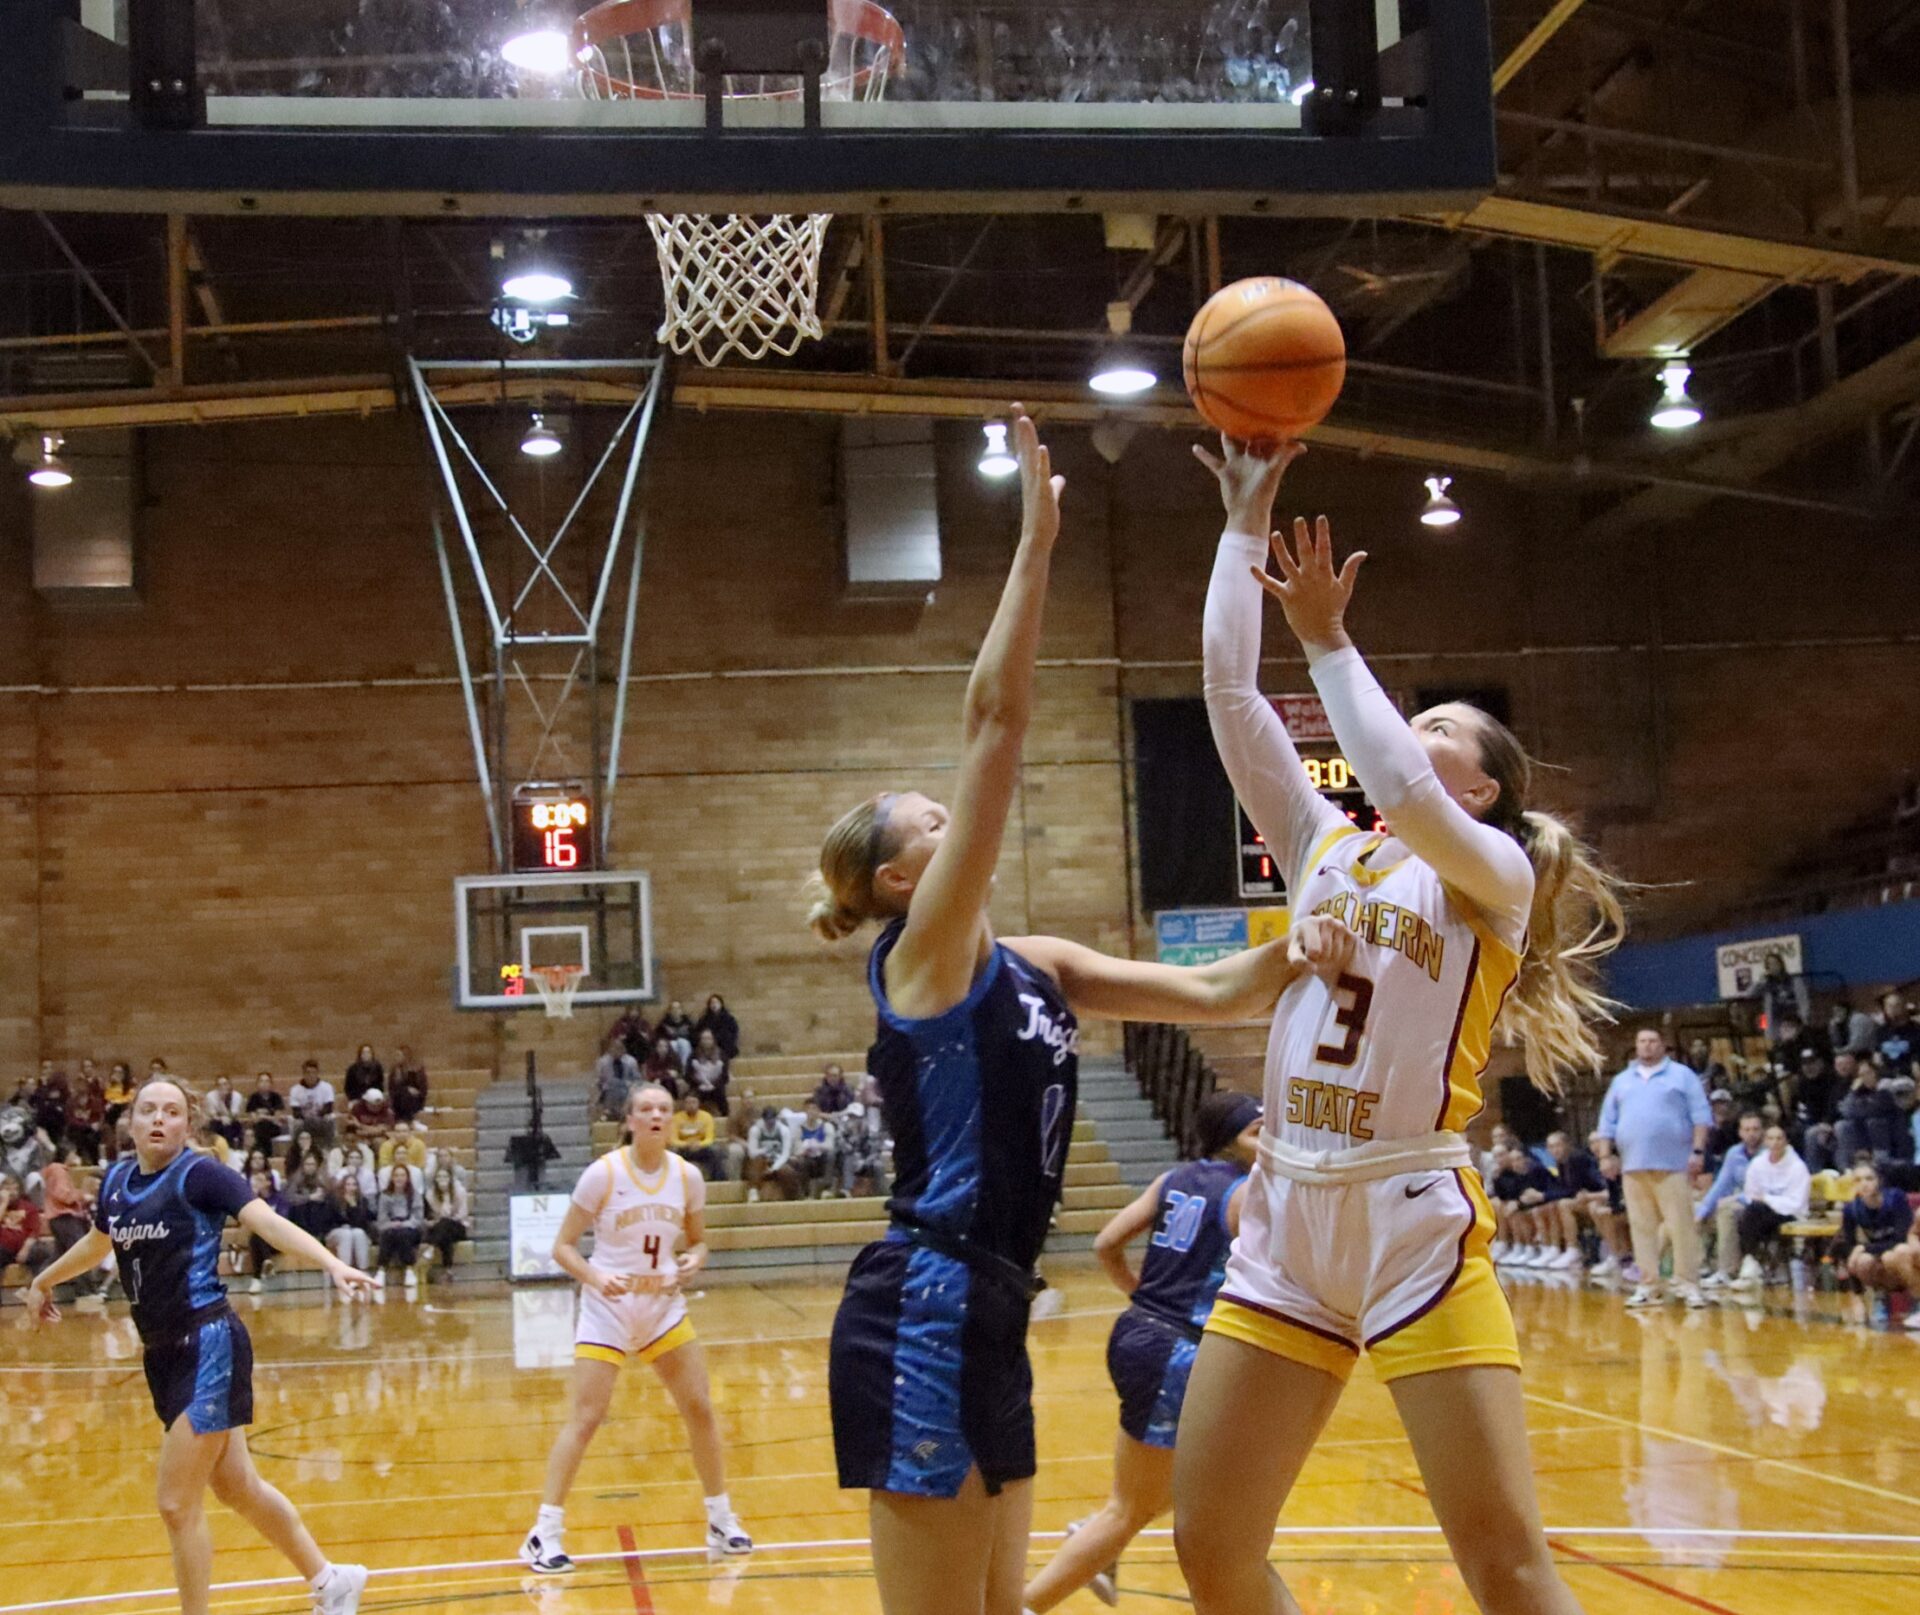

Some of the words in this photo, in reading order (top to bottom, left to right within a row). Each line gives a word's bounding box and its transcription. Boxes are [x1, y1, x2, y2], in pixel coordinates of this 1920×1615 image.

[532, 803, 587, 829] 8:09
[545, 828, 577, 867] 16
[1315, 971, 1375, 1068] 3
[1286, 1076, 1381, 1141] STATE
[532, 1197, 549, 1213] N
[1151, 1189, 1208, 1253] 30
[107, 1215, 170, 1251] Trojans
[643, 1234, 661, 1270] 4
